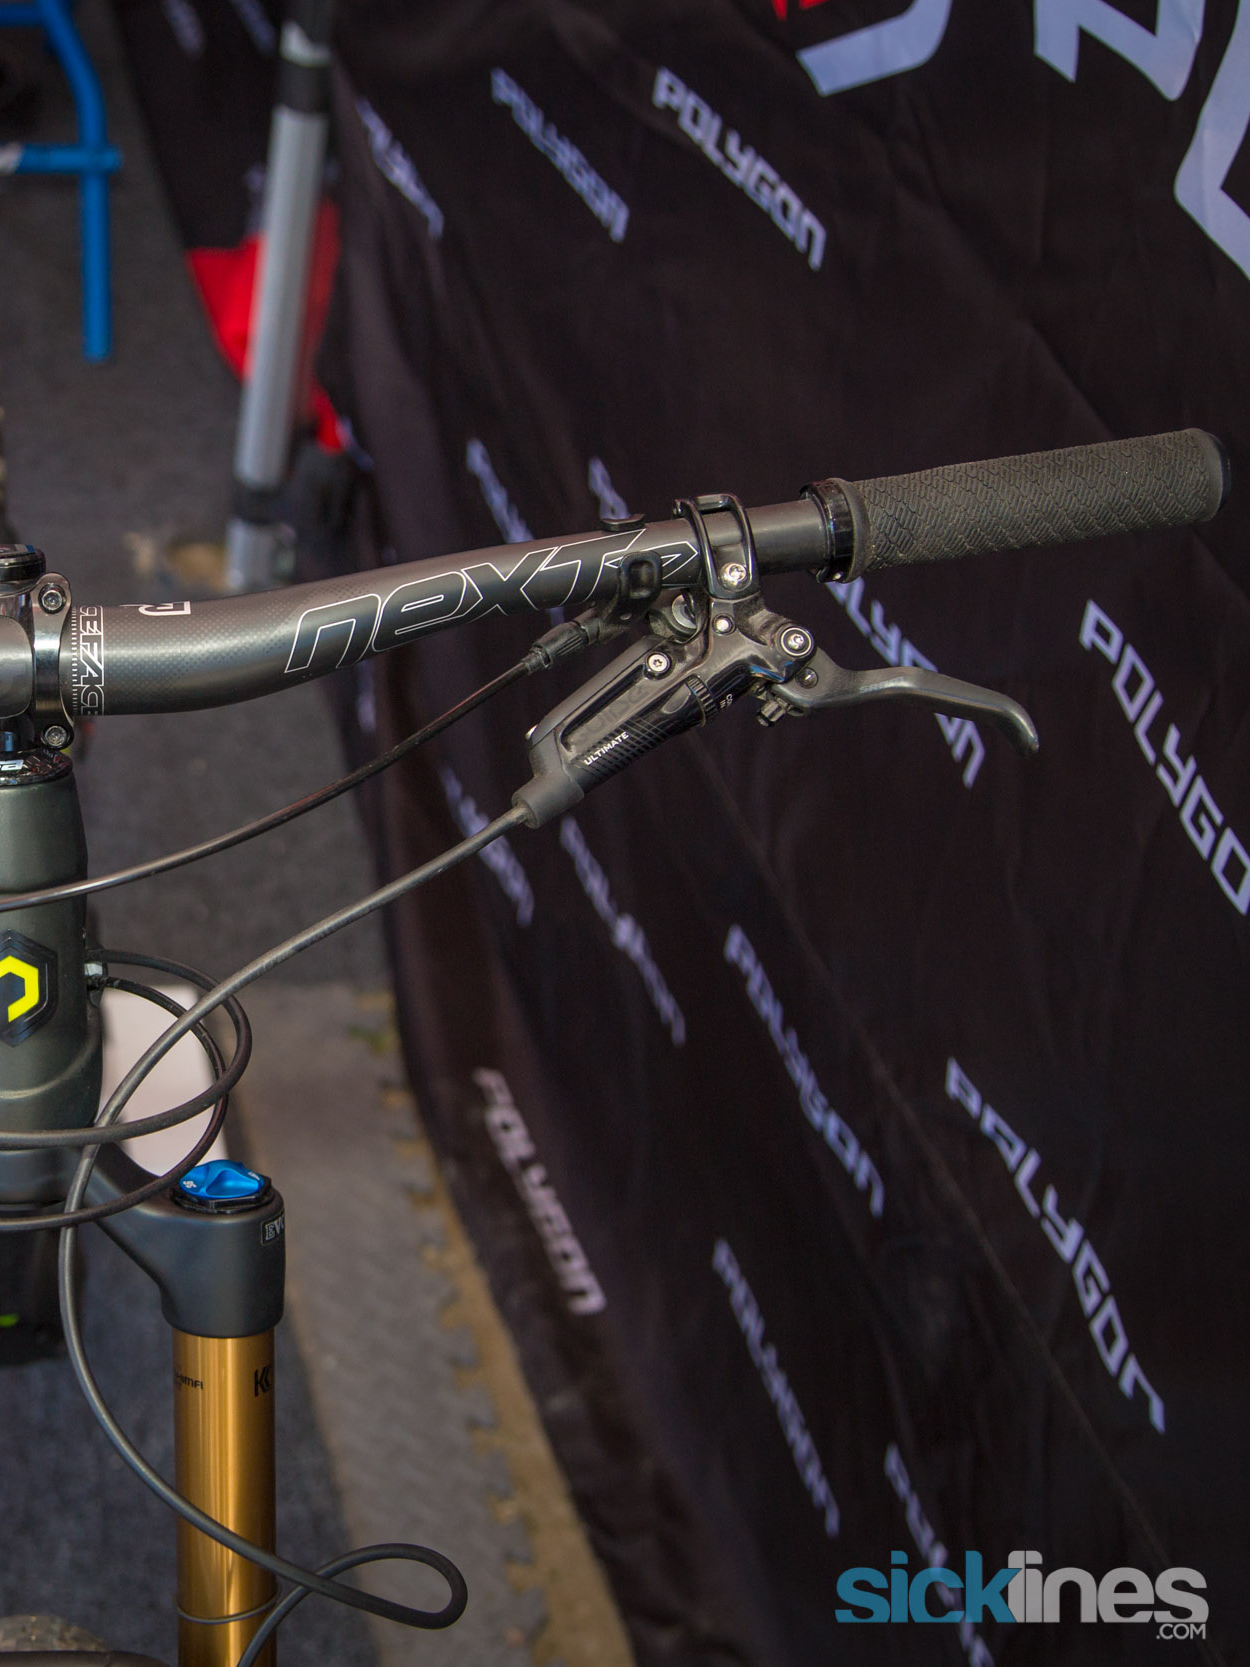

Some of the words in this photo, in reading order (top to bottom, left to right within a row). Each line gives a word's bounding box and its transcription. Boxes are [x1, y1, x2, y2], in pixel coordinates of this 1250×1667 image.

[652, 66, 827, 272] POLYGON
[584, 731, 630, 766] ULTIMATE
[945, 1057, 1165, 1435] POLYGON
